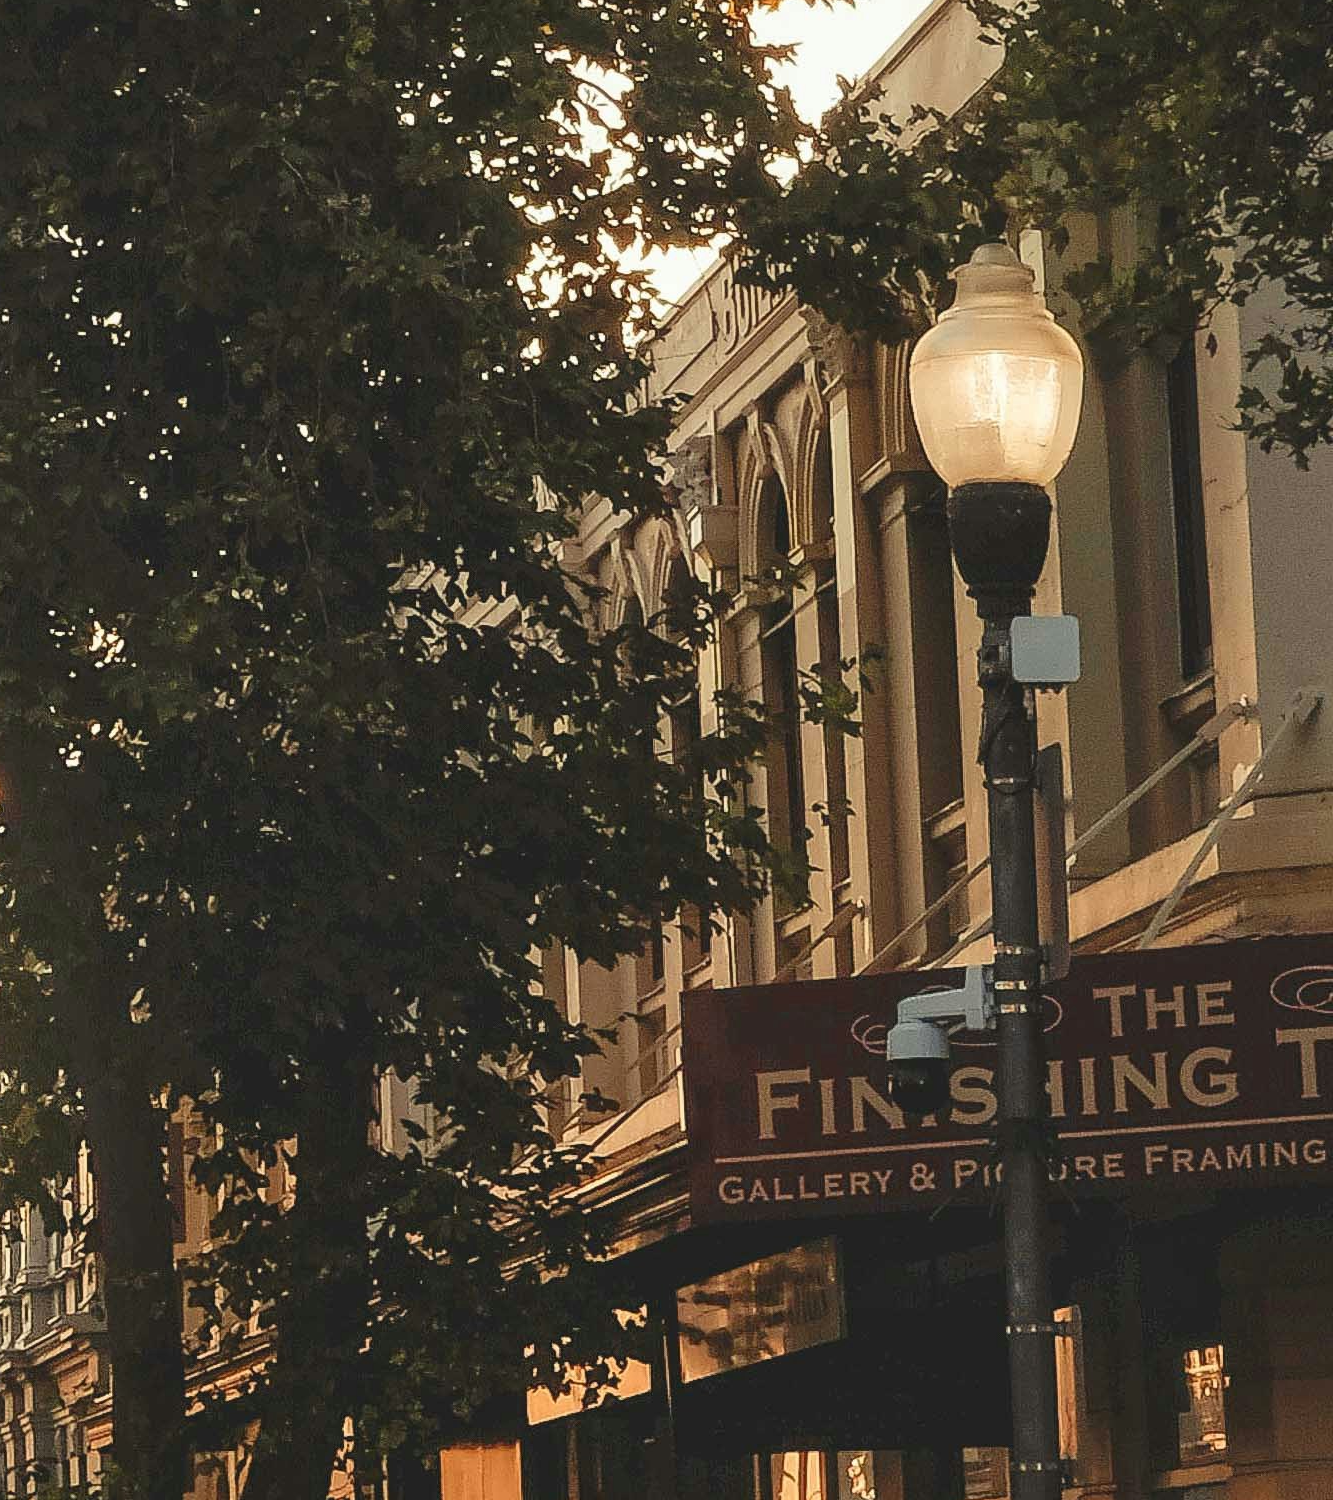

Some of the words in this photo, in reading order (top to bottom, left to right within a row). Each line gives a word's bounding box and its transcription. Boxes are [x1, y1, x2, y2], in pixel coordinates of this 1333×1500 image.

[1092, 980, 1236, 1038] THE
[755, 1046, 1239, 1140] FINSING
[718, 1168, 894, 1204] GALLERY
[910, 1162, 935, 1192] &
[953, 1152, 1126, 1190] PIURE
[1144, 1139, 1327, 1176] FRAMING
